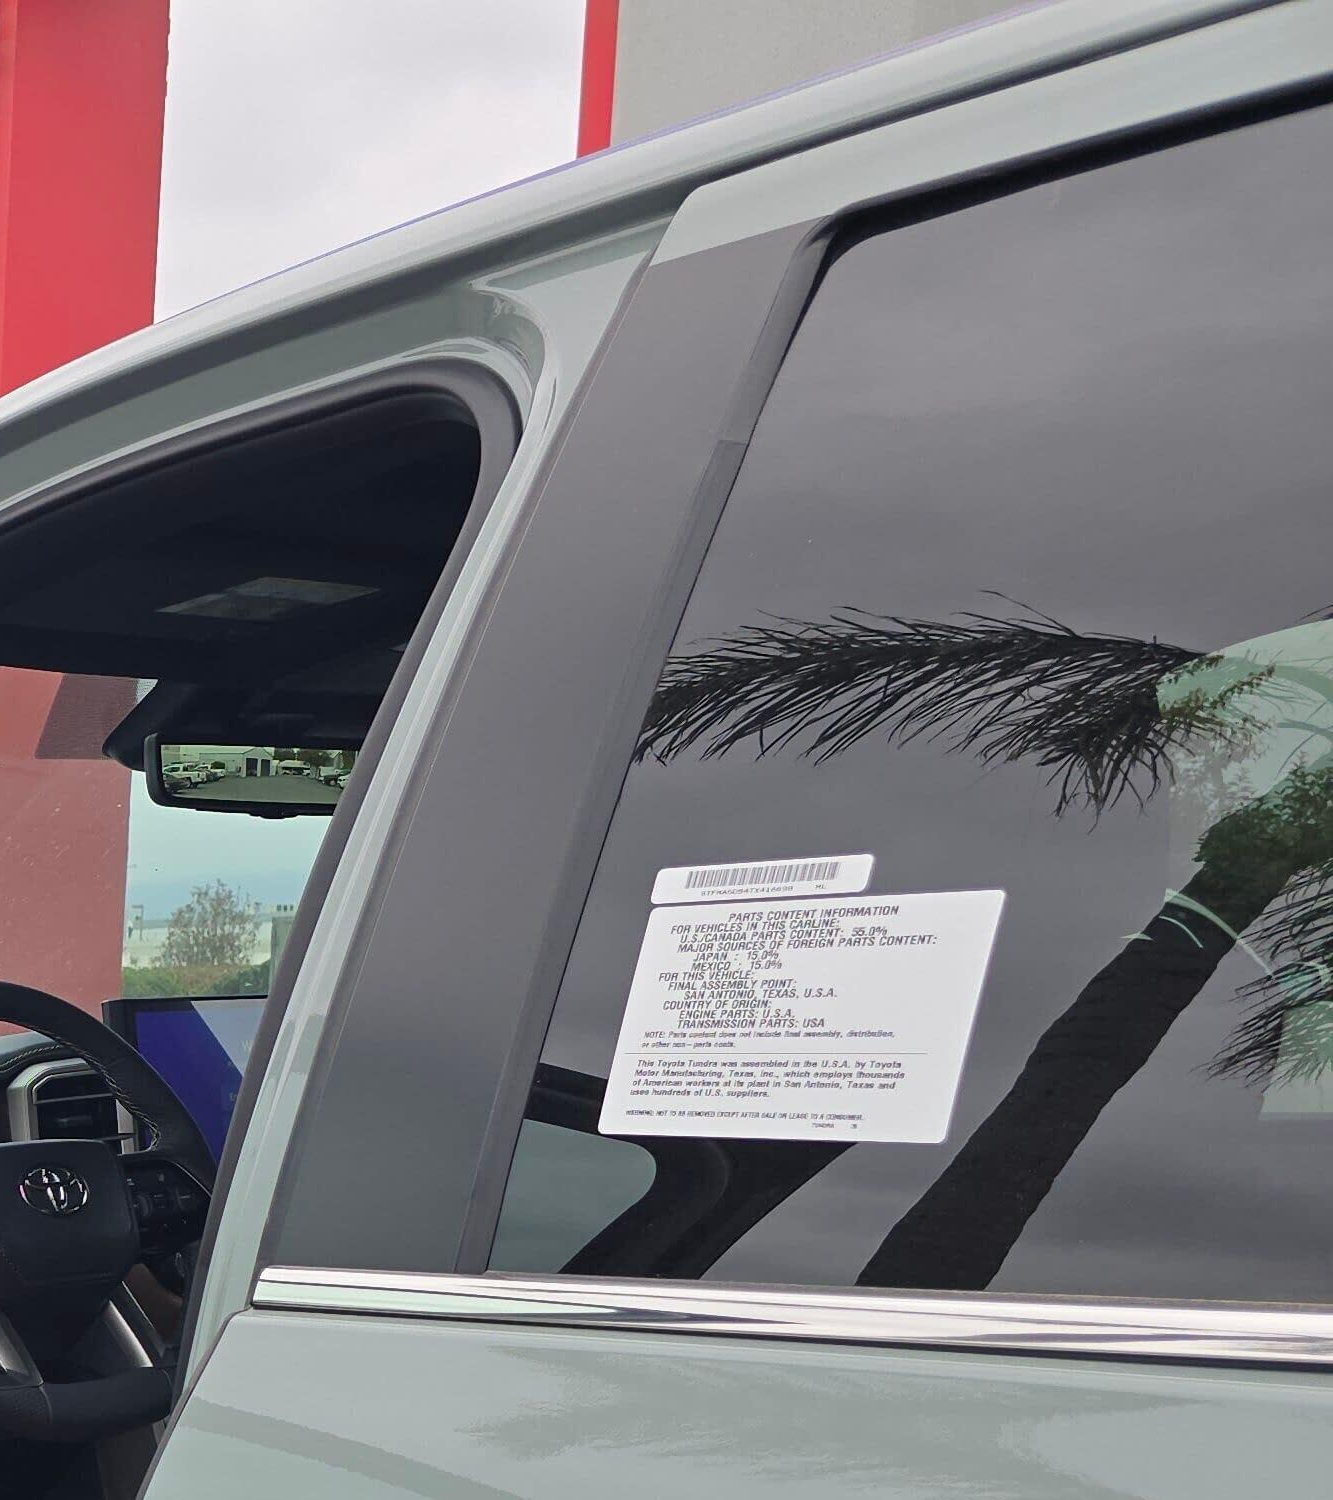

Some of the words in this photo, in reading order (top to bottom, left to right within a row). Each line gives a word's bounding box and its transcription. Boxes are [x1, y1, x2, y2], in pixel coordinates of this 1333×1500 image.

[728, 911, 764, 922] PARTS
[767, 908, 817, 921] CONTENT
[820, 905, 900, 918] INFORMATION
[670, 924, 691, 935] FOR
[695, 922, 743, 934] VEHICLES
[746, 921, 758, 931] IN
[762, 920, 786, 931] THIS
[789, 918, 841, 930] CARLINE:
[680, 932, 747, 943] U.S./CANADA
[750, 930, 786, 941] PARTS
[790, 928, 844, 940] CONTENT:
[851, 926, 888, 937] 55.0%
[677, 943, 714, 953] MAJOR
[717, 941, 766, 952] SOURCES
[769, 940, 783, 950] OF
[787, 938, 834, 950] FOREIGN
[837, 936, 876, 948] PARTS
[879, 934, 938, 946] CONTENT:
[695, 951, 728, 961] JAPAN
[747, 950, 780, 960] 15.0%
[691, 961, 731, 972] MEXICO
[750, 960, 783, 971] 15.0%
[659, 972, 678, 982] FOR
[682, 971, 705, 981] THIS
[709, 970, 755, 980] VEHICLE:
[668, 981, 697, 991] FINAL
[700, 980, 758, 990] ASSEMBLY
[760, 978, 797, 989] POINT:
[684, 991, 705, 1001] SAN
[708, 989, 758, 1000] ANTONIO,
[762, 988, 799, 999] TEXAS,
[804, 988, 838, 998] U.S.A.
[663, 1000, 711, 1010] COUNTRY
[714, 1000, 730, 1009] OF
[731, 999, 772, 1010] ORIGIN:
[679, 1009, 716, 1019] ENGINE
[720, 1008, 758, 1019] PARTS:
[762, 1008, 796, 1018] U.S.A.
[677, 1019, 755, 1029] TRANSMISSION
[759, 1018, 799, 1029] PARTS:
[803, 1018, 825, 1028] USA
[657, 1060, 685, 1069] Toyota
[688, 1060, 718, 1068] Tundra
[740, 1060, 788, 1068] assembled
[791, 1060, 800, 1068] in
[803, 1060, 818, 1068] the
[821, 1060, 850, 1068] U.S.A.
[855, 1060, 866, 1070] by
[870, 1060, 902, 1070] Toyota
[634, 1069, 660, 1077] Motor
[661, 1069, 725, 1079] Manufacturing,
[729, 1070, 756, 1078] Texas,
[783, 1070, 810, 1078] which
[813, 1071, 853, 1080] employs
[856, 1071, 906, 1080] thousands
[632, 1079, 642, 1087] of
[643, 1079, 683, 1087] American
[734, 1080, 744, 1088] its
[746, 1080, 770, 1089] plant
[773, 1080, 781, 1088] in
[783, 1080, 801, 1088] San
[804, 1080, 843, 1090] Antonio,
[847, 1080, 874, 1089] Texas
[877, 1081, 896, 1089] and
[651, 1088, 691, 1096] hundreds
[704, 1089, 724, 1097] U.S.
[726, 1089, 771, 1099] suppliers.
